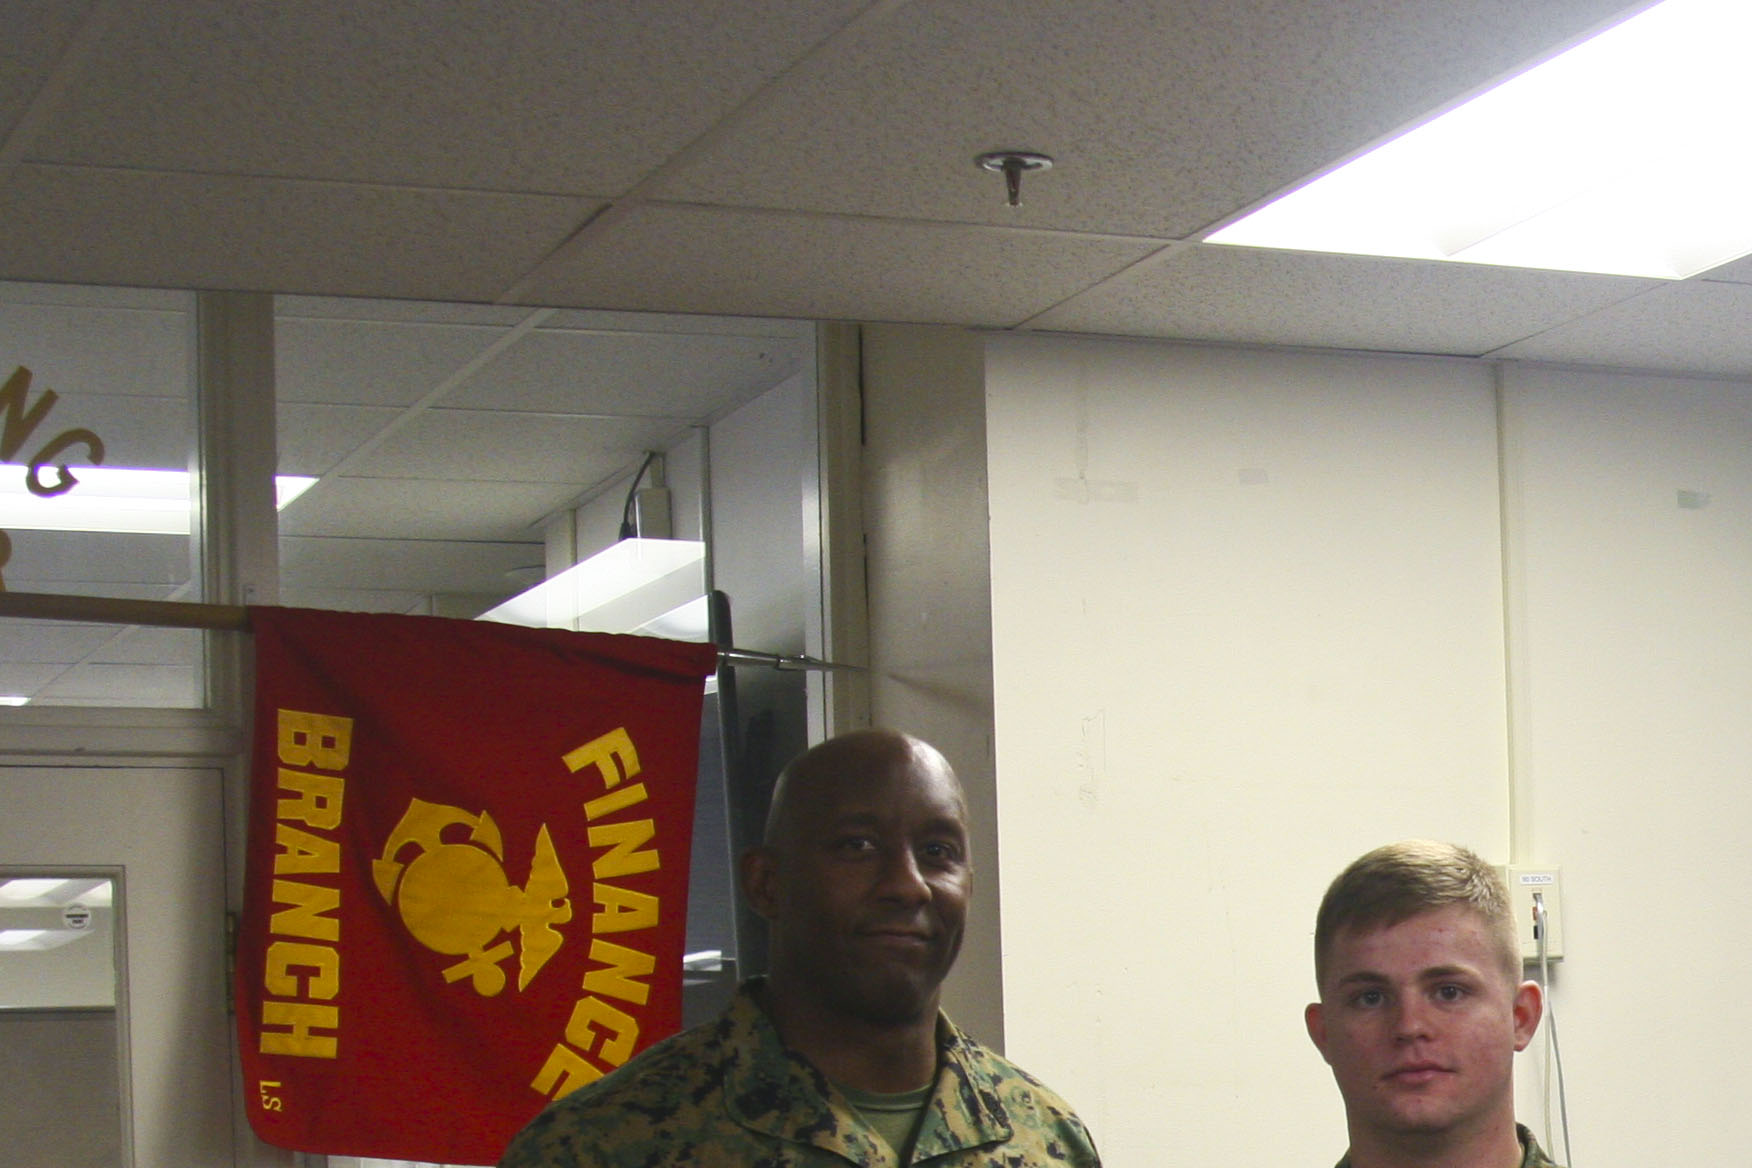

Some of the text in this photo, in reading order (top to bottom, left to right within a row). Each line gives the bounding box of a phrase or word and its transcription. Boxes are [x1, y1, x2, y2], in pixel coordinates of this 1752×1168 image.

[259, 708, 354, 1059] BRANCH
[530, 727, 661, 1101] FINANCE
[259, 1080, 282, 1112] LS
